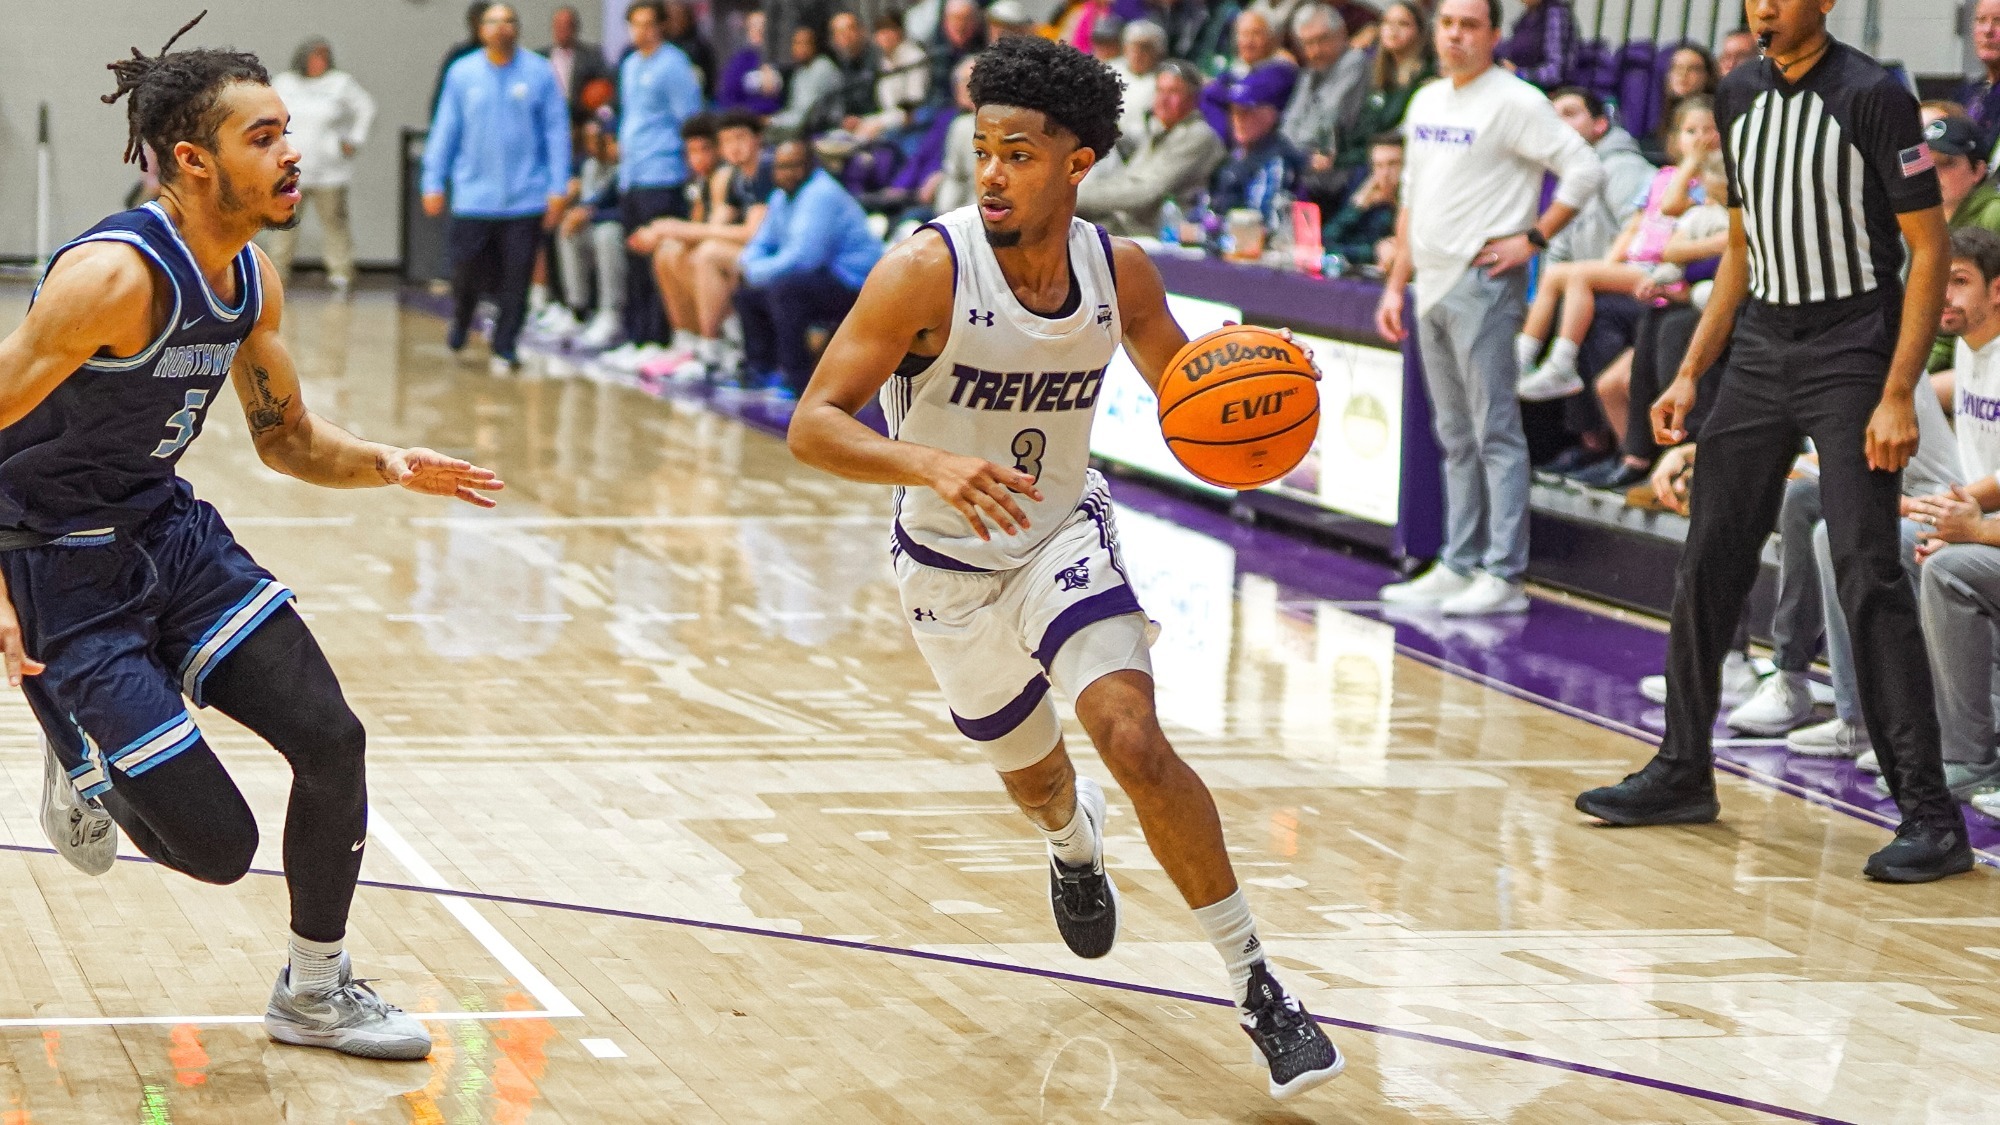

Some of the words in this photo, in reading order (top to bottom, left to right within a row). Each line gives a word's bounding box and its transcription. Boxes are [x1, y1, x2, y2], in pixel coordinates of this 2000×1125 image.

[152, 338, 240, 378] NORTHWO
[1181, 342, 1294, 383] Wilson
[949, 362, 1109, 412] TREVECC
[150, 388, 211, 459] 5
[1221, 391, 1283, 425] EVO
[1006, 428, 1046, 493] 3
[1261, 983, 1275, 1001] CUR
